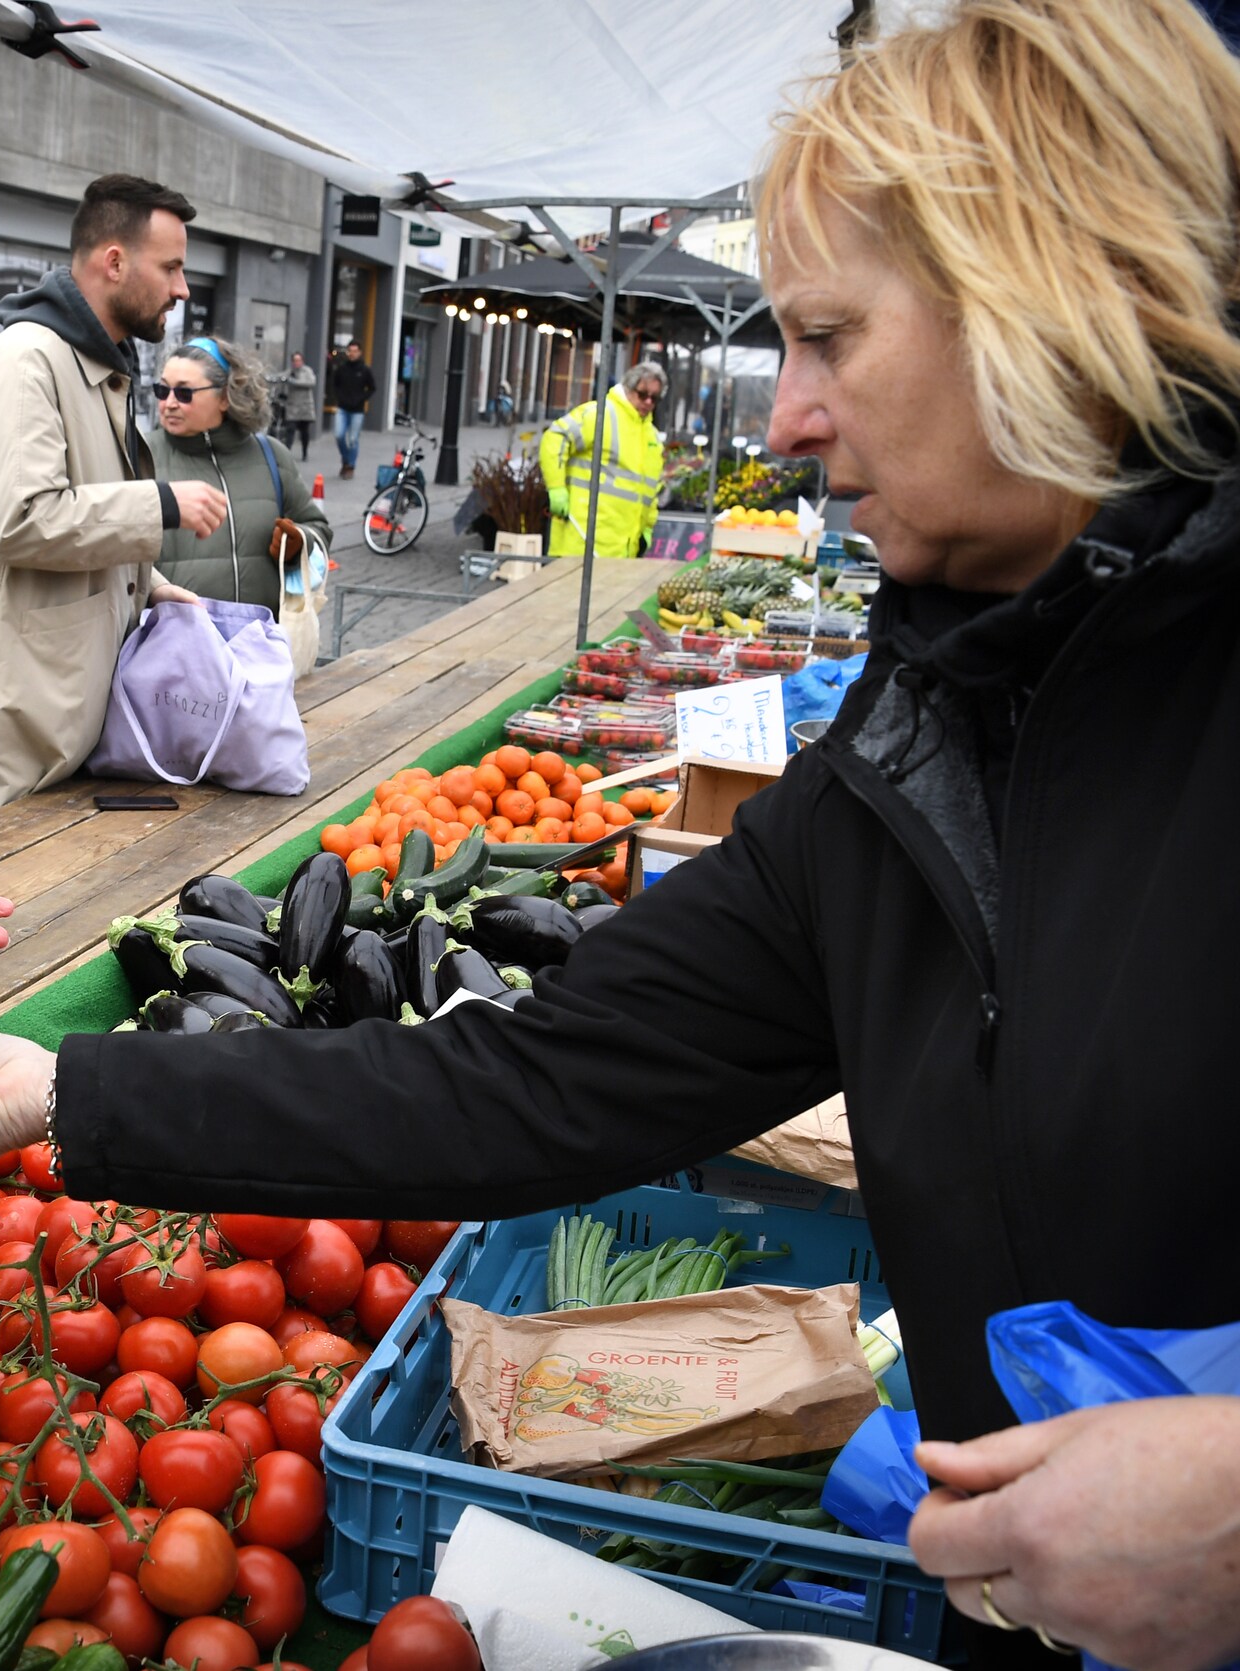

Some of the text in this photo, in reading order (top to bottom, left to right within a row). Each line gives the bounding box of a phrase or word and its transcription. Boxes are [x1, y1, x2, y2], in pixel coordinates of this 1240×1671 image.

[588, 1352, 708, 1366] GROENTE
[715, 1357, 739, 1401] & FRUIT
